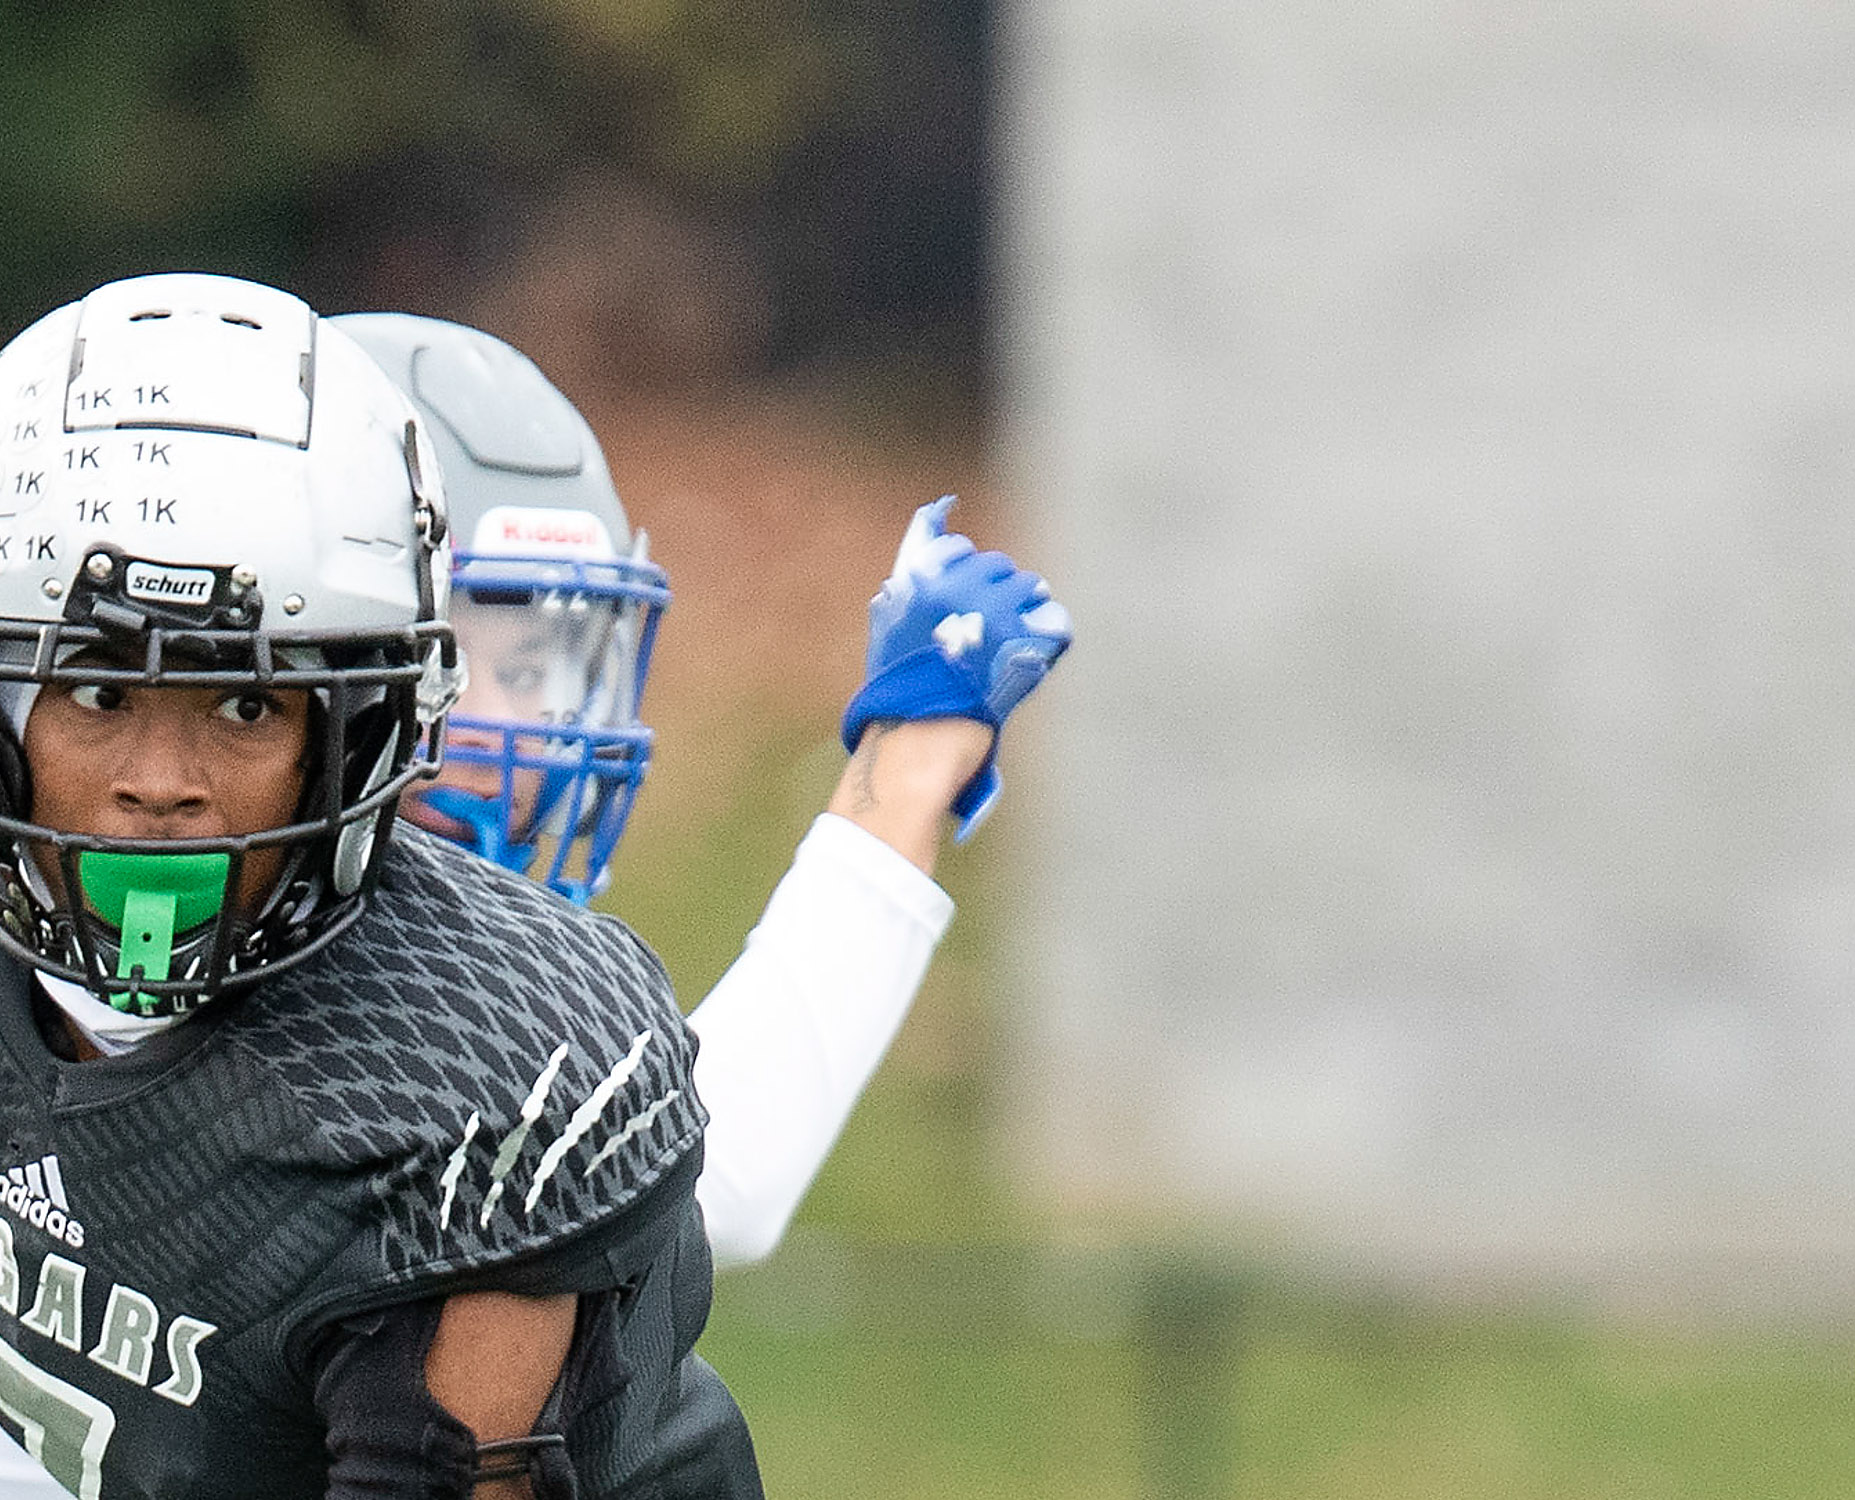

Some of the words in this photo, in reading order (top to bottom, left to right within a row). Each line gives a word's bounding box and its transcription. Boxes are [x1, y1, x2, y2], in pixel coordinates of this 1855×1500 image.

[75, 387, 113, 411] 1K
[134, 384, 170, 405] 1K
[13, 419, 41, 442] 1K
[63, 446, 101, 470] 1K
[133, 441, 171, 466] 1K
[15, 470, 45, 495] 1K
[76, 498, 112, 524] 1K
[137, 498, 177, 525] 1K
[25, 534, 56, 561] 1K
[132, 574, 208, 597] schutt
